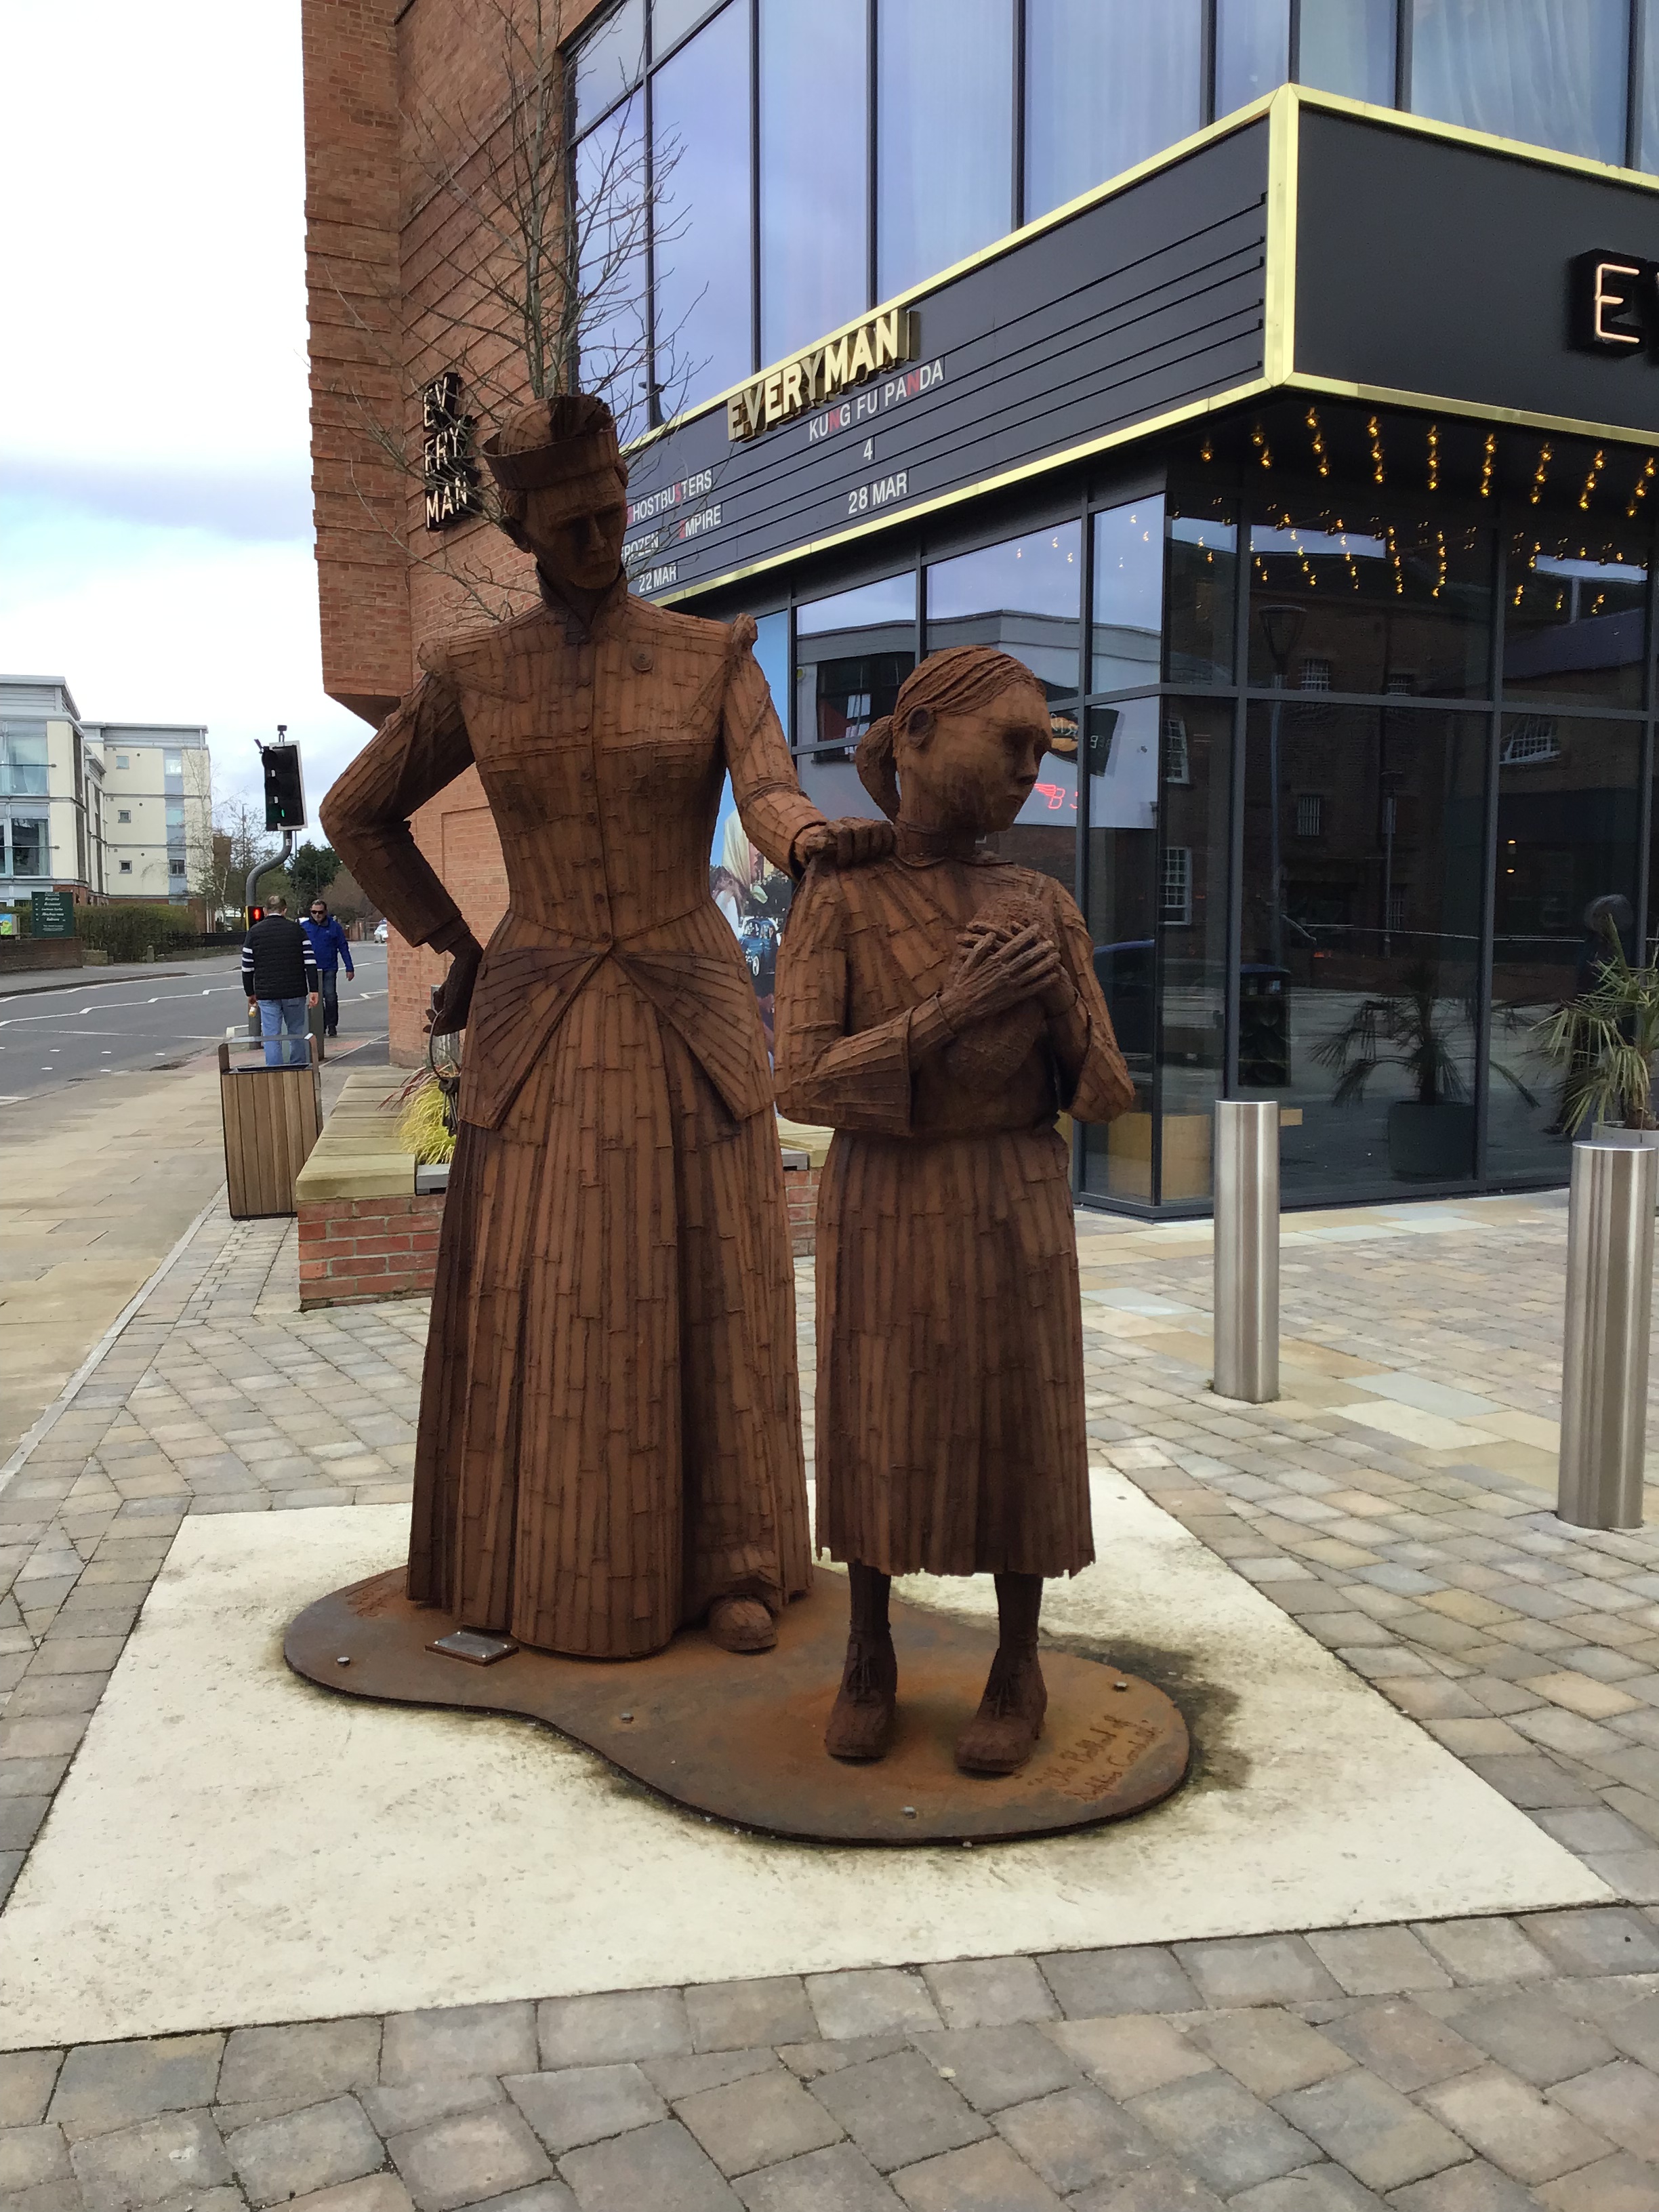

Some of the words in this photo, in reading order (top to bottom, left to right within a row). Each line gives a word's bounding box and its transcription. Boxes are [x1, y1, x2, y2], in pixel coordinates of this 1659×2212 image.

[726, 308, 900, 442] EVERYMAN
[808, 403, 851, 442] KUNG
[857, 388, 878, 420] FU
[884, 359, 944, 407] PANDA
[863, 437, 873, 461] 4
[425, 470, 468, 529] MAN
[848, 486, 868, 515] 28
[872, 471, 907, 506] MAR
[678, 504, 722, 540] EMPIRE
[638, 573, 653, 593] 22
[653, 561, 677, 588] MAR
